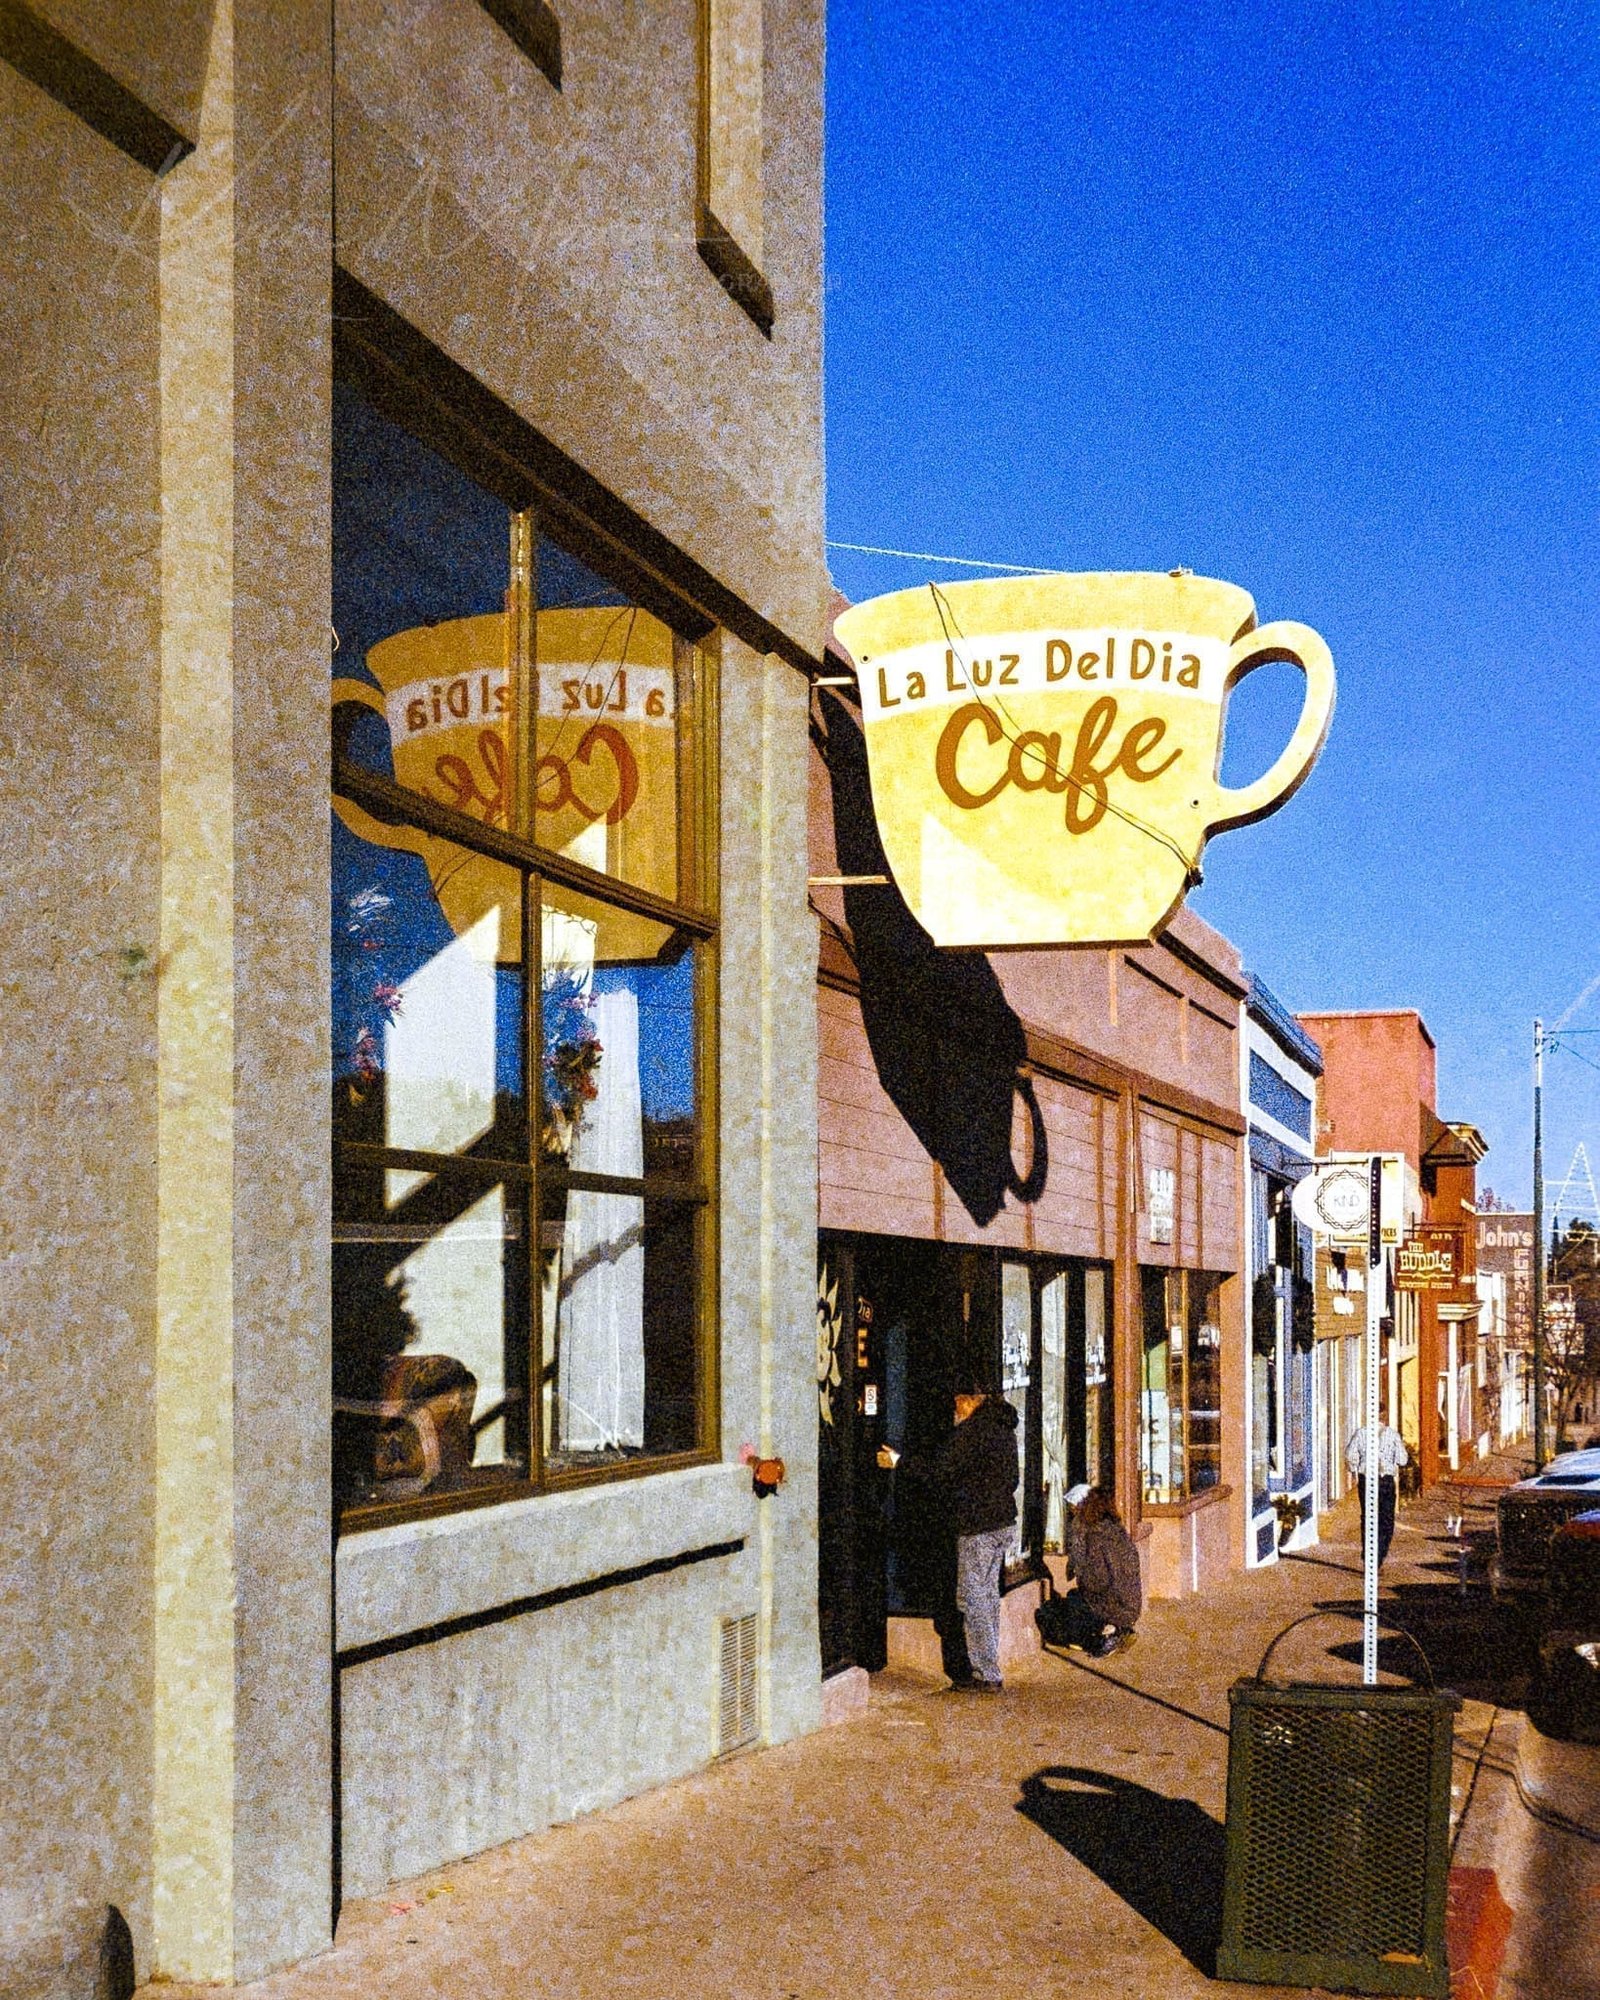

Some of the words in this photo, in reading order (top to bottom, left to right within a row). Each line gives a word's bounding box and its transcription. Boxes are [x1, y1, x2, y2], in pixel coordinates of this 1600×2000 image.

[877, 668, 926, 708] La
[945, 649, 1020, 691] Luz
[1045, 637, 1116, 682] Del
[1130, 638, 1201, 689] Dia
[935, 695, 1184, 836] Cafe
[1475, 1221, 1533, 1249] John's
[1398, 1250, 1452, 1271] HUDDLE
